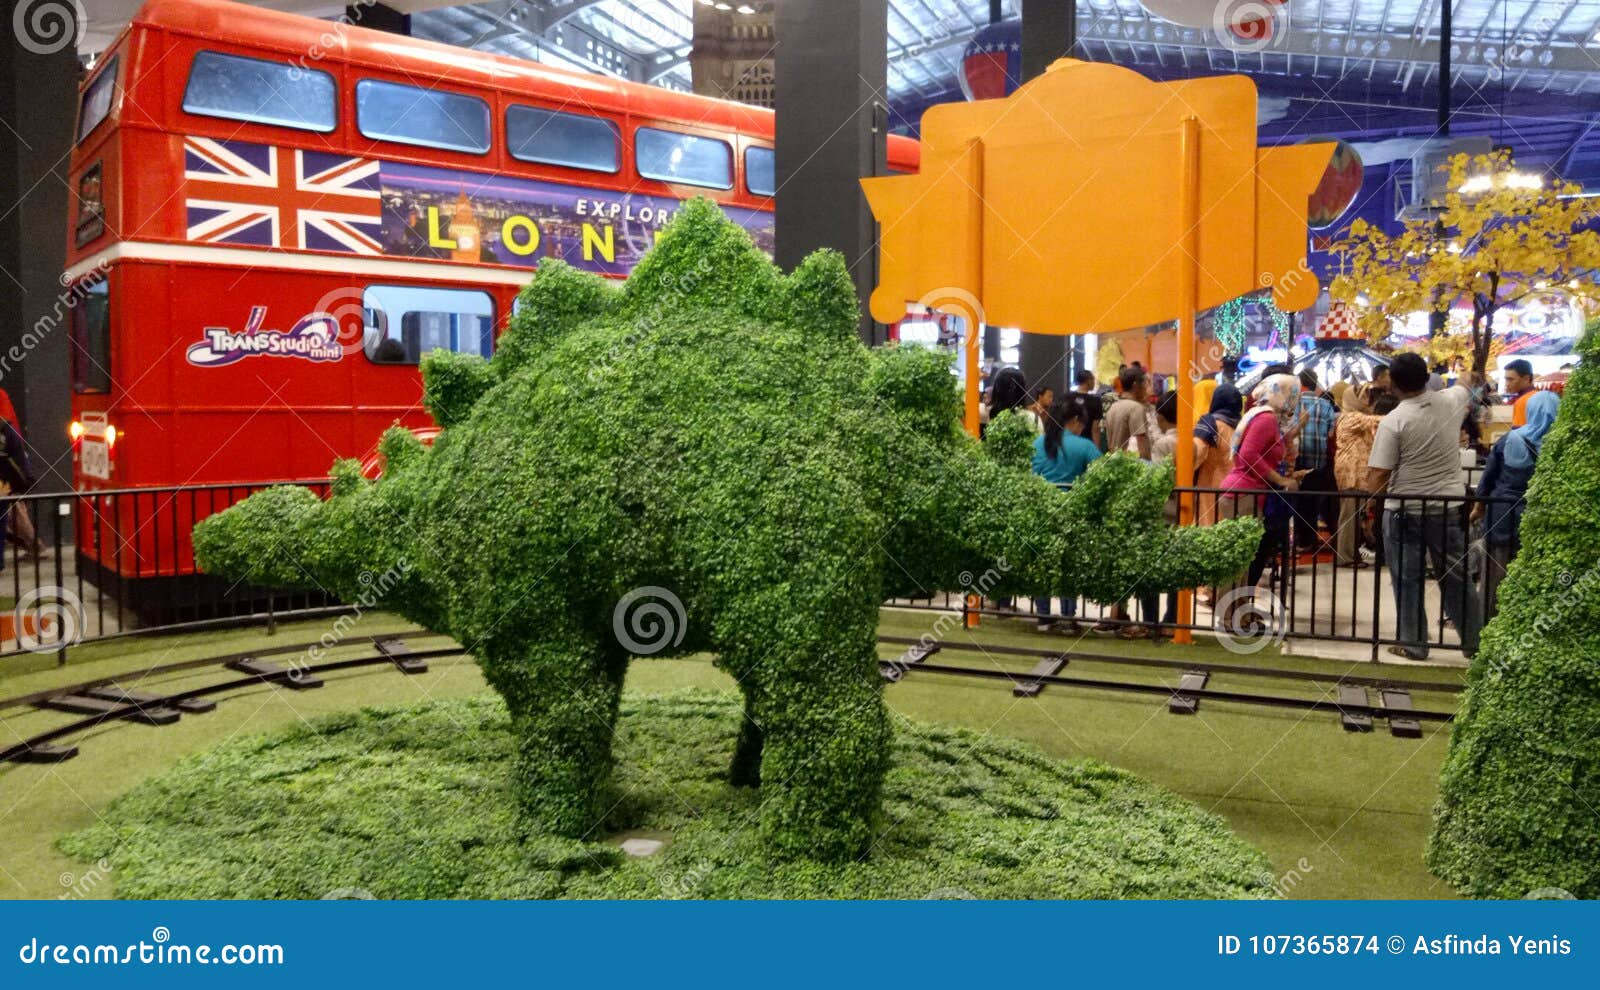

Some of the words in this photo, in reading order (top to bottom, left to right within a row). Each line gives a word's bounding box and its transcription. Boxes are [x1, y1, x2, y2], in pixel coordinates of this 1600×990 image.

[576, 199, 678, 225] EXPLOR
[427, 206, 665, 263] LON
[310, 345, 340, 359] mini
